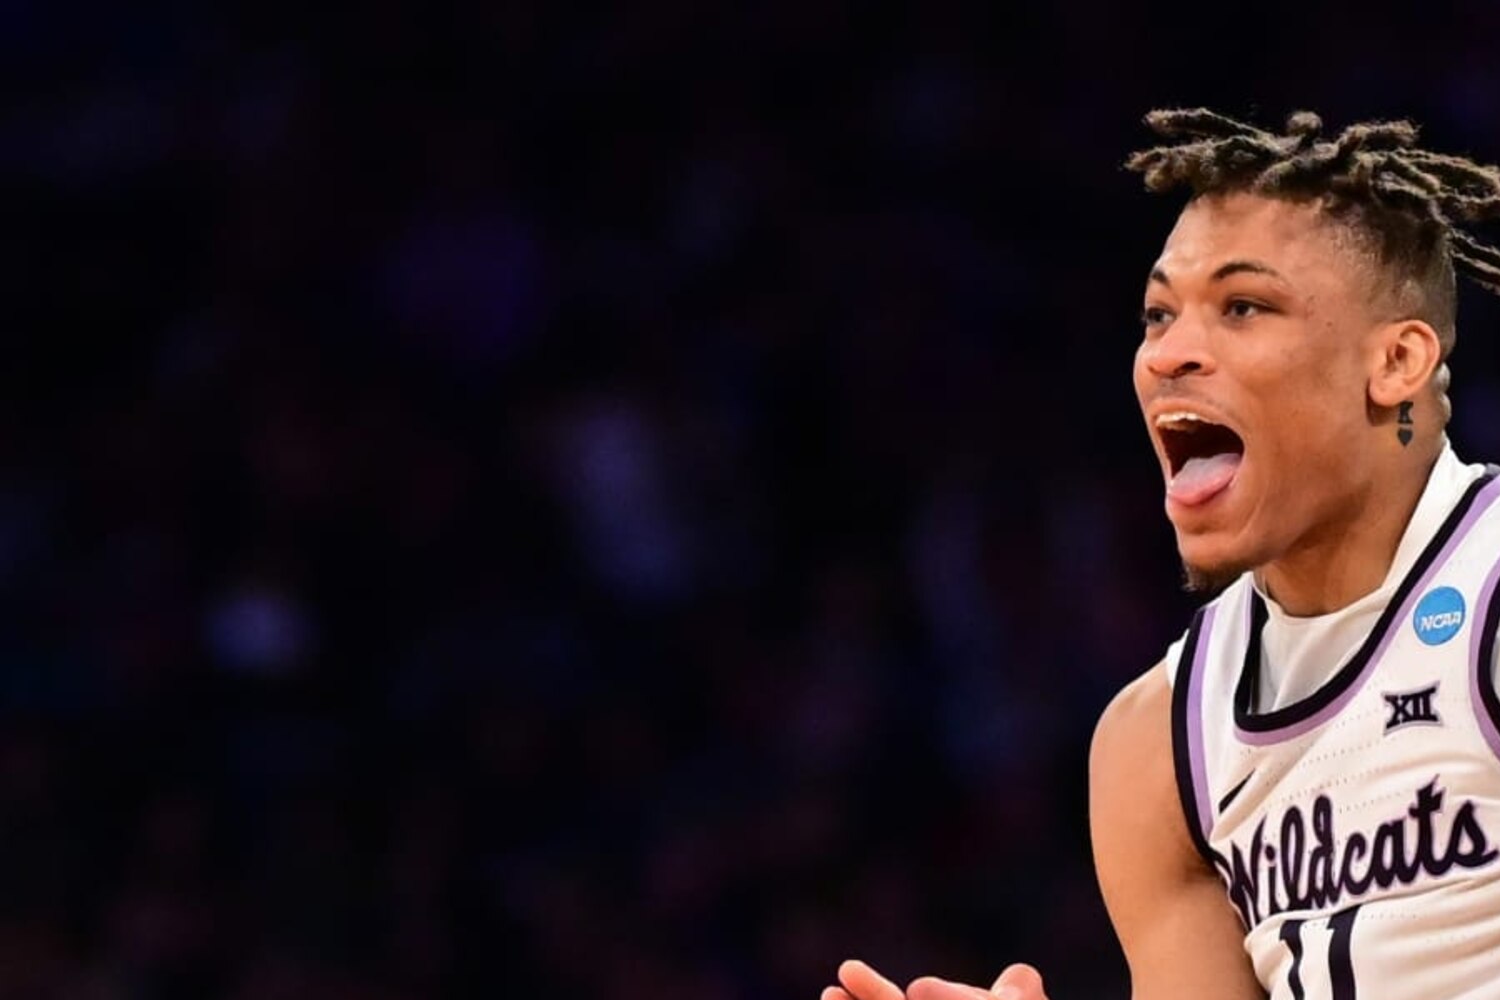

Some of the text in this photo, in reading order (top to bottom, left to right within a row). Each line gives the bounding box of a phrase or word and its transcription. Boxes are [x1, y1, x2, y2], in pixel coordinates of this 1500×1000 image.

[1420, 610, 1462, 632] NCAA
[1383, 684, 1441, 733] XII
[1213, 775, 1500, 932] Wildcats
